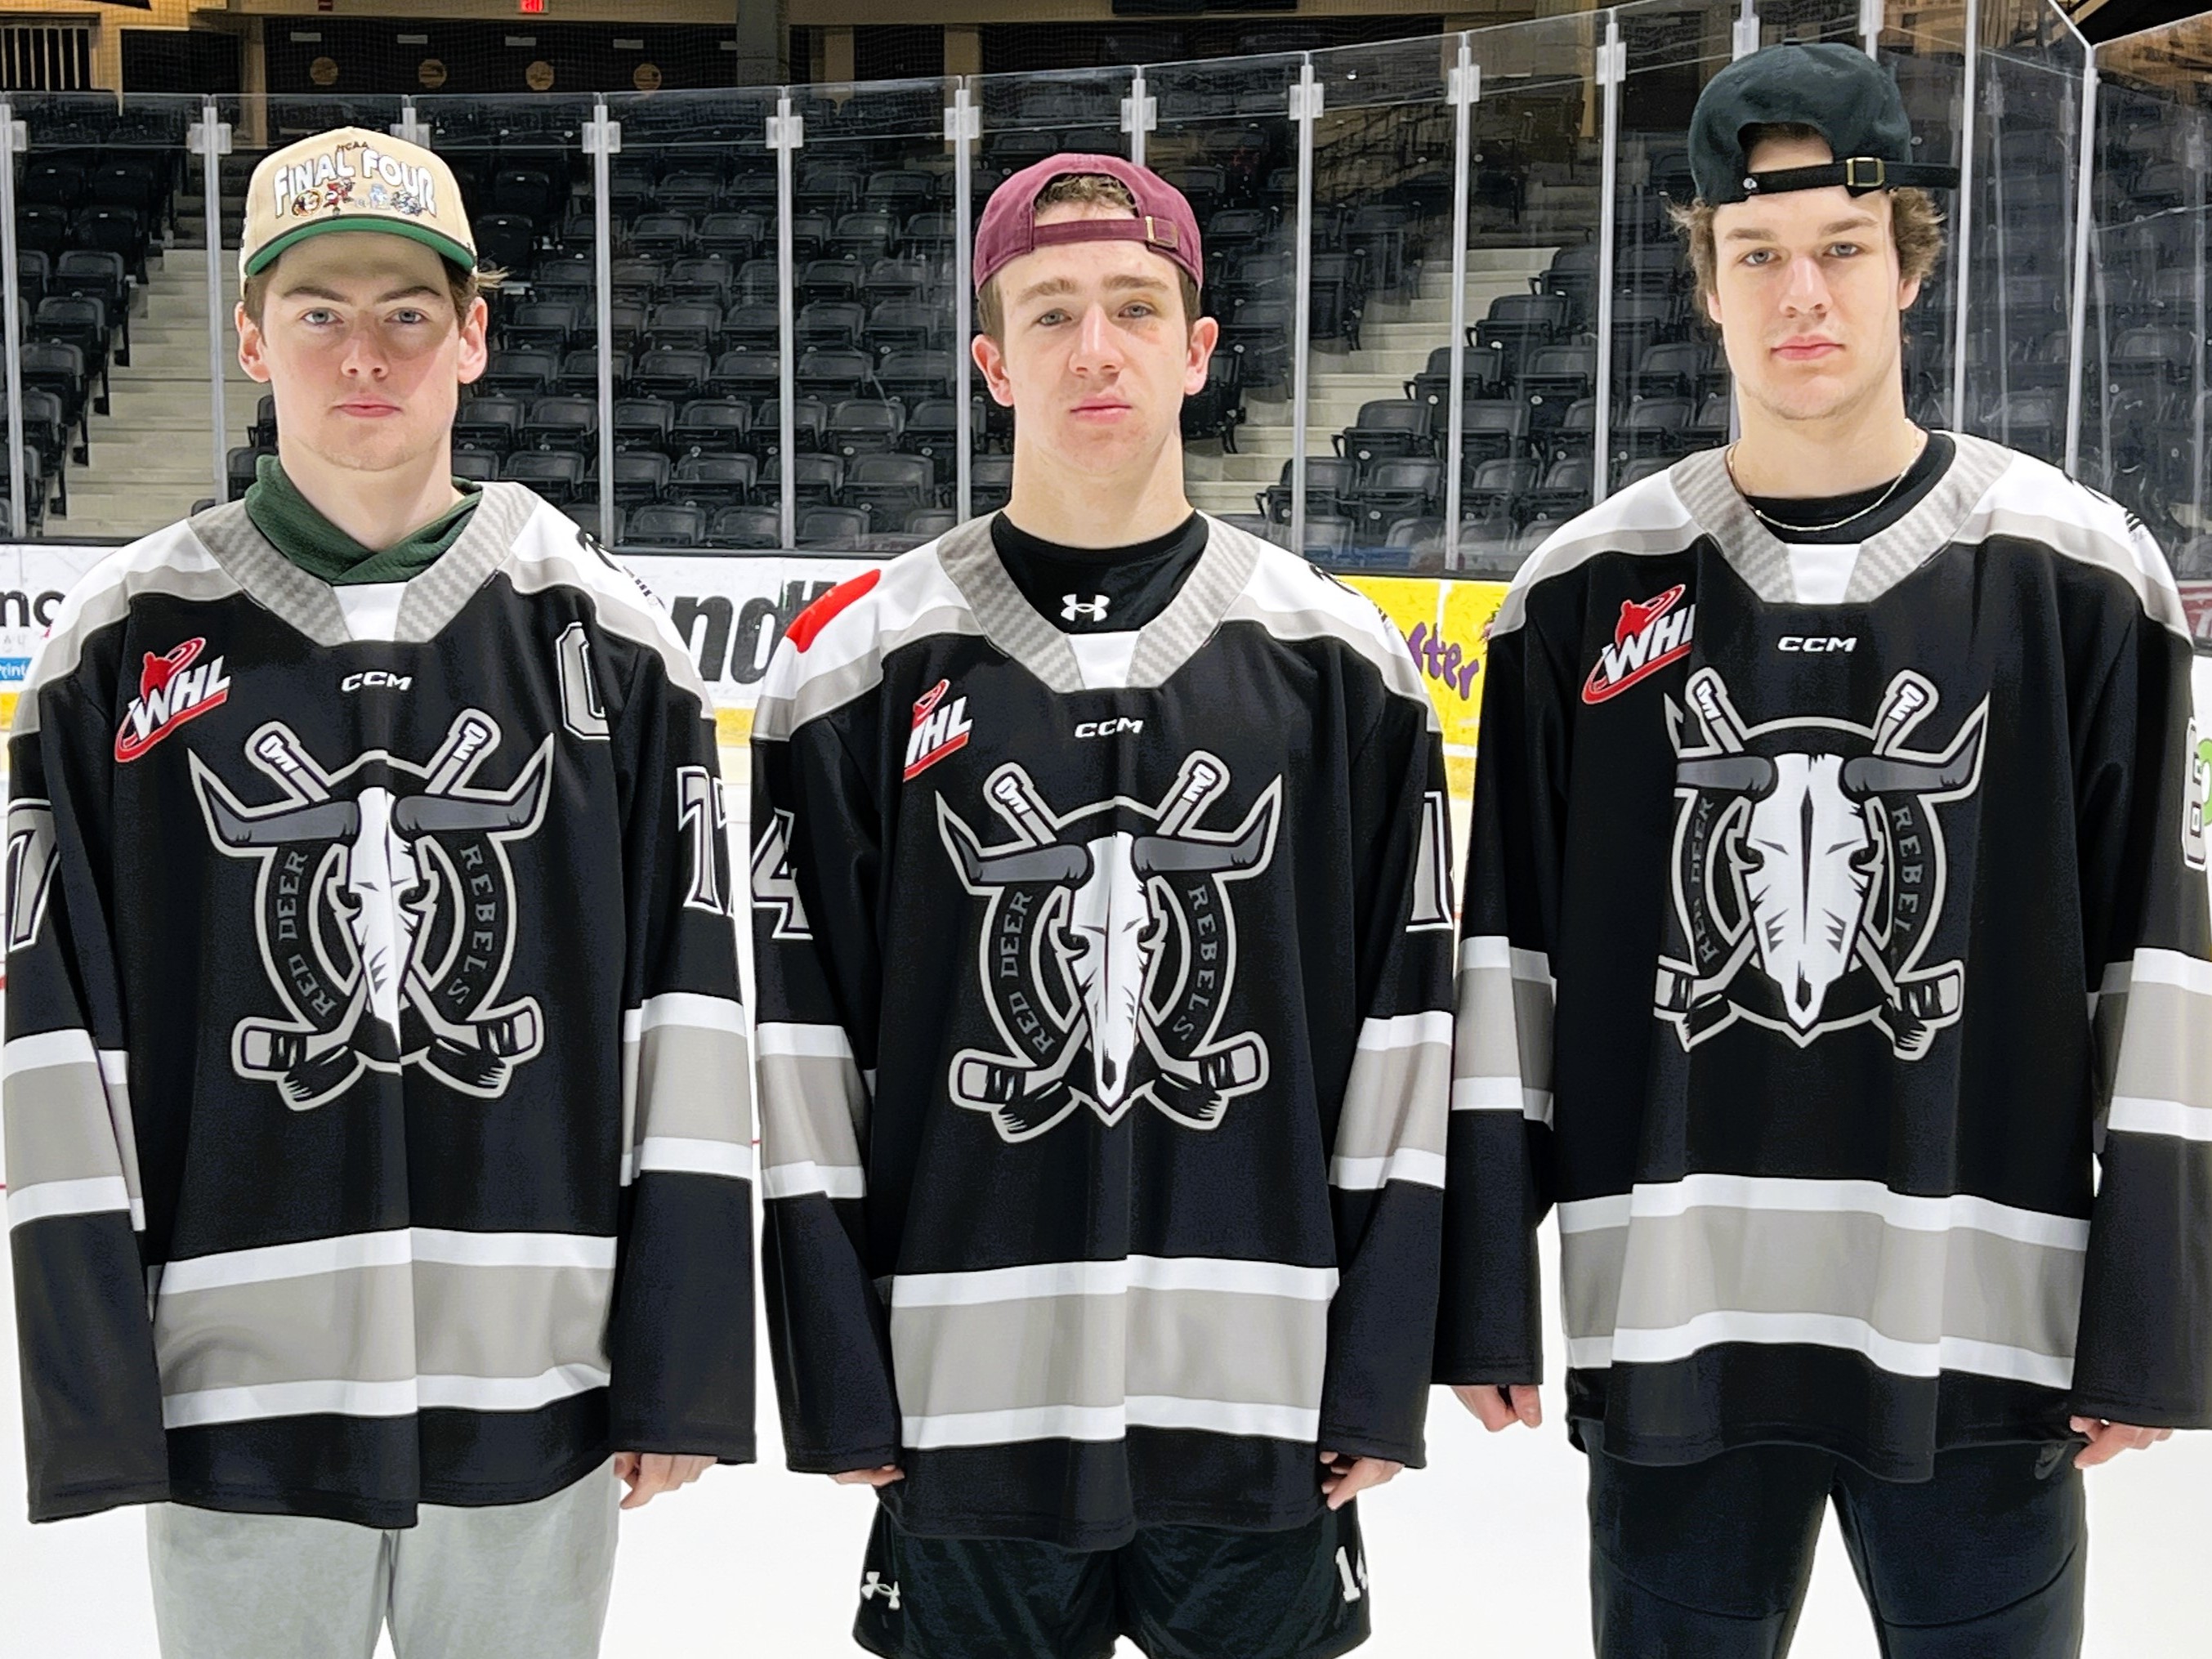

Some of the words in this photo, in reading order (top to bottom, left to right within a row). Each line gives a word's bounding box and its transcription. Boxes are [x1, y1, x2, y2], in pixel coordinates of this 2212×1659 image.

[273, 150, 355, 218] FINAL
[361, 149, 437, 218] FOUR
[1777, 636, 1857, 653] CCM
[127, 655, 231, 741] WHL
[342, 671, 412, 692] CCM
[1075, 717, 1144, 738] CCM
[277, 851, 309, 941] DEER
[449, 843, 496, 1005] REBELS
[1000, 891, 1034, 979] DEER
[1173, 885, 1216, 1040] REBELS
[288, 955, 337, 1017] RED
[1009, 991, 1056, 1054] RED
